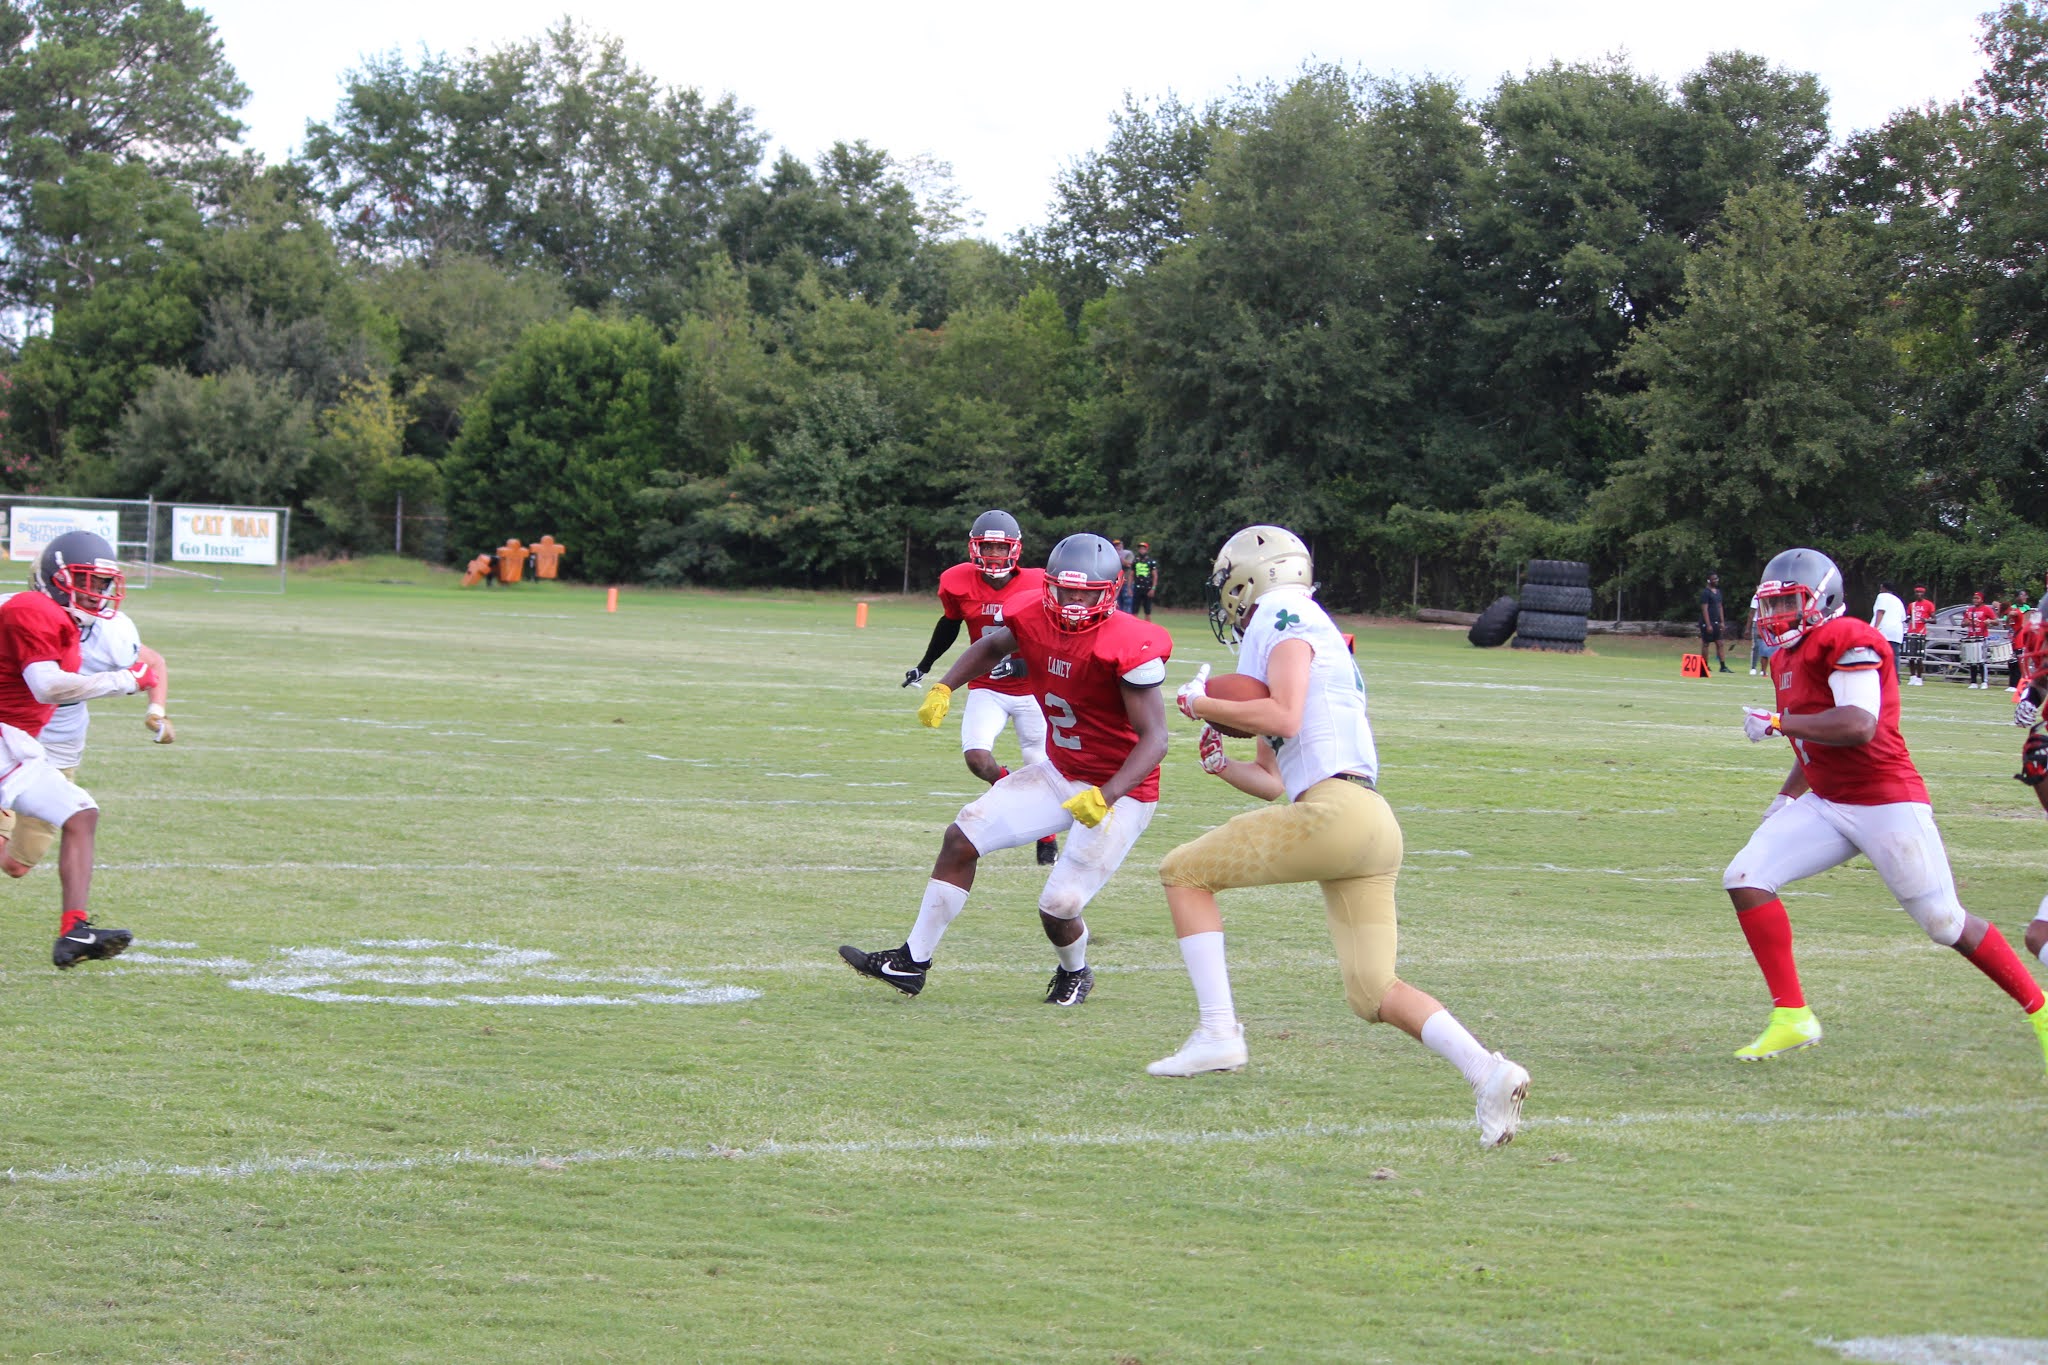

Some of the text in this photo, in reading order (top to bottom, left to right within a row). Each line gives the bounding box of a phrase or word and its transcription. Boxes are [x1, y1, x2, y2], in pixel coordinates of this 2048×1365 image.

[192, 514, 269, 538] CAT MAN
[1048, 656, 1072, 679] LANEY
[1684, 655, 1698, 672] 20
[1045, 692, 1082, 750] 2
